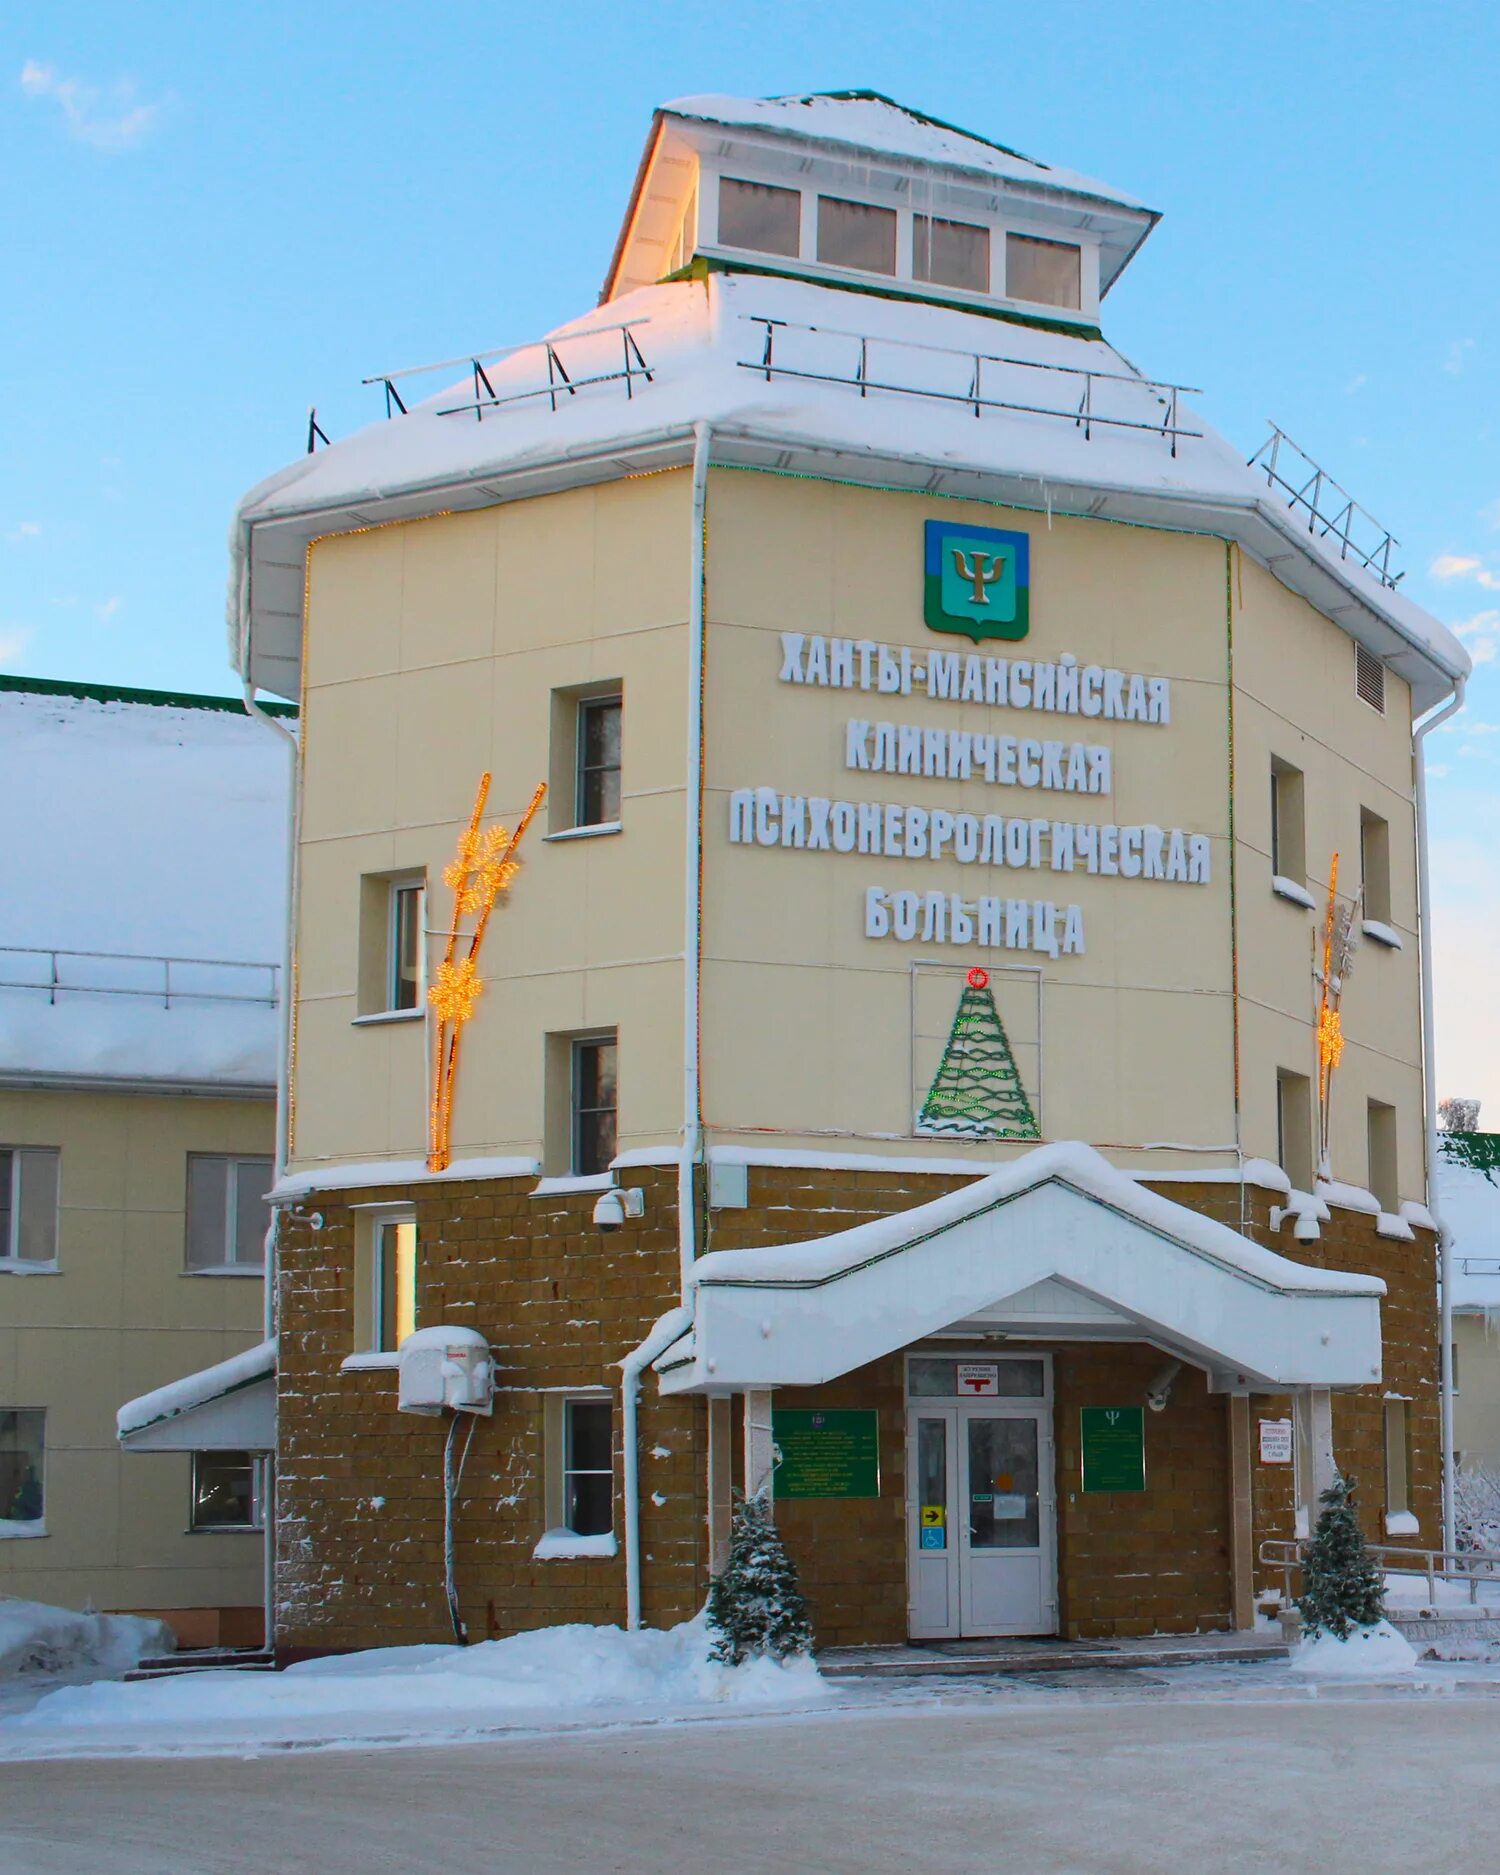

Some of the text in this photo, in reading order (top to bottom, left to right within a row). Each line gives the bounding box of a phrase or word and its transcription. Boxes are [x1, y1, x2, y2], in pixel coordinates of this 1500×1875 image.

[779, 632, 1172, 724] ХАНТЫ-МАНСИЙСКАЯ
[846, 718, 1112, 795] КЛИНИЧЕСКАЯ
[729, 786, 1211, 884] ПСИХОНЕВРОЛОГИЧЕСКАЯ
[865, 885, 1086, 959] БОЛЬНИЦА
